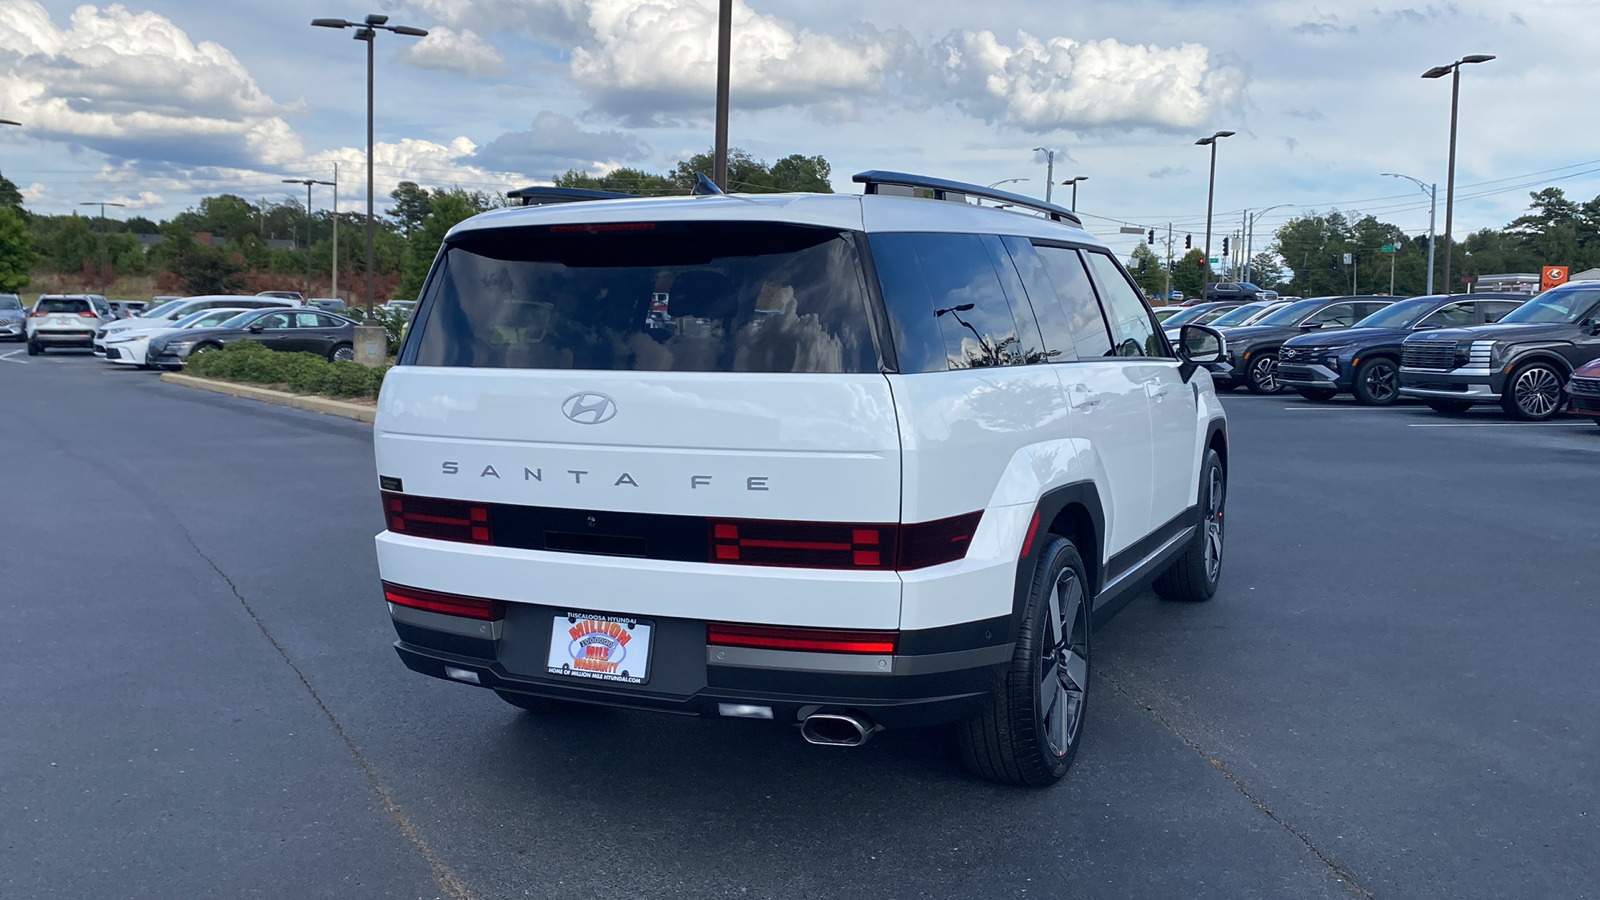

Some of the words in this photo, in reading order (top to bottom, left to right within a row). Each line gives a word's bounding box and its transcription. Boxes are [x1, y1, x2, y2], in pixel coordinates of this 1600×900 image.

[442, 461, 639, 488] SANTA
[691, 475, 769, 491] FE
[567, 612, 606, 621] TUSCALOOSA
[607, 616, 637, 625] HYUNDAI
[568, 619, 632, 647] MILLION
[586, 645, 610, 661] MILE
[571, 670, 592, 678] MILLION
[574, 658, 619, 674] WARRANTY
